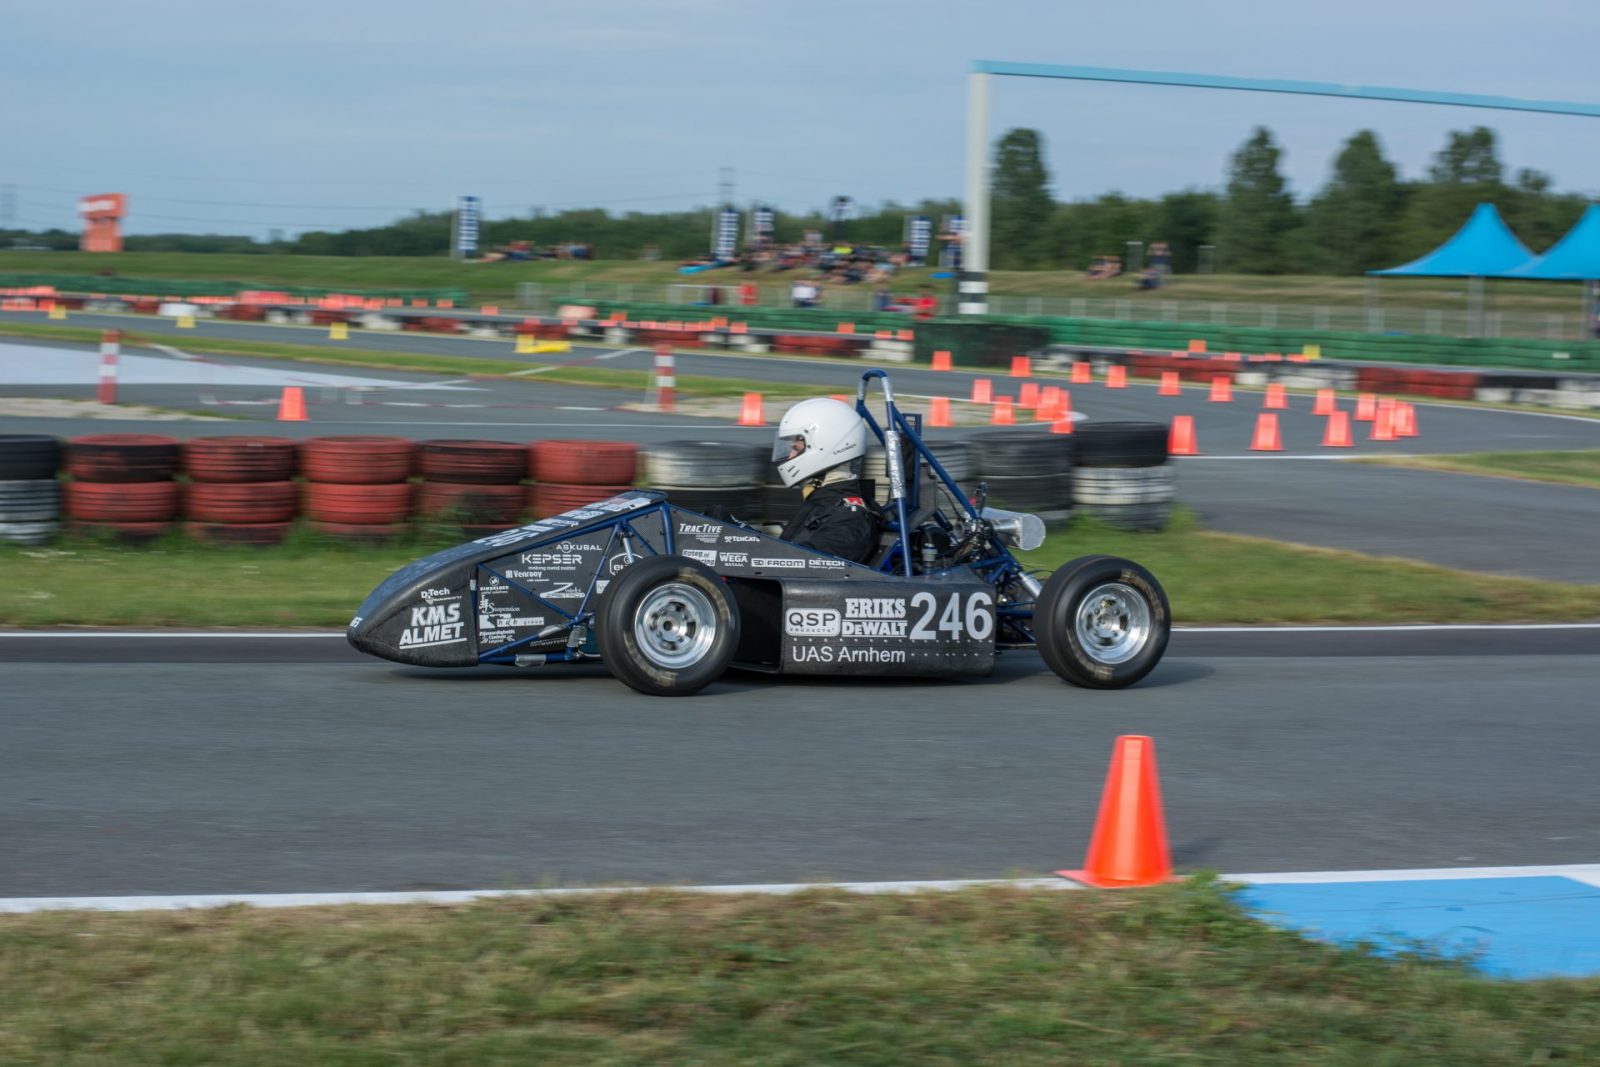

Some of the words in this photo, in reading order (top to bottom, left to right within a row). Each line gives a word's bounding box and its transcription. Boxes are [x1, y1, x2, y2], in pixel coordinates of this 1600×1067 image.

[556, 543, 602, 551] ASKUBAL
[522, 554, 582, 564] KEPSER
[719, 553, 748, 563] WEGA
[411, 602, 461, 627] KMS
[845, 598, 906, 618] ERIKS
[909, 591, 993, 640] 246
[788, 612, 836, 627] QSP
[399, 622, 464, 646] ALMET
[792, 646, 833, 662] UAS
[837, 646, 906, 662] Arnhem
